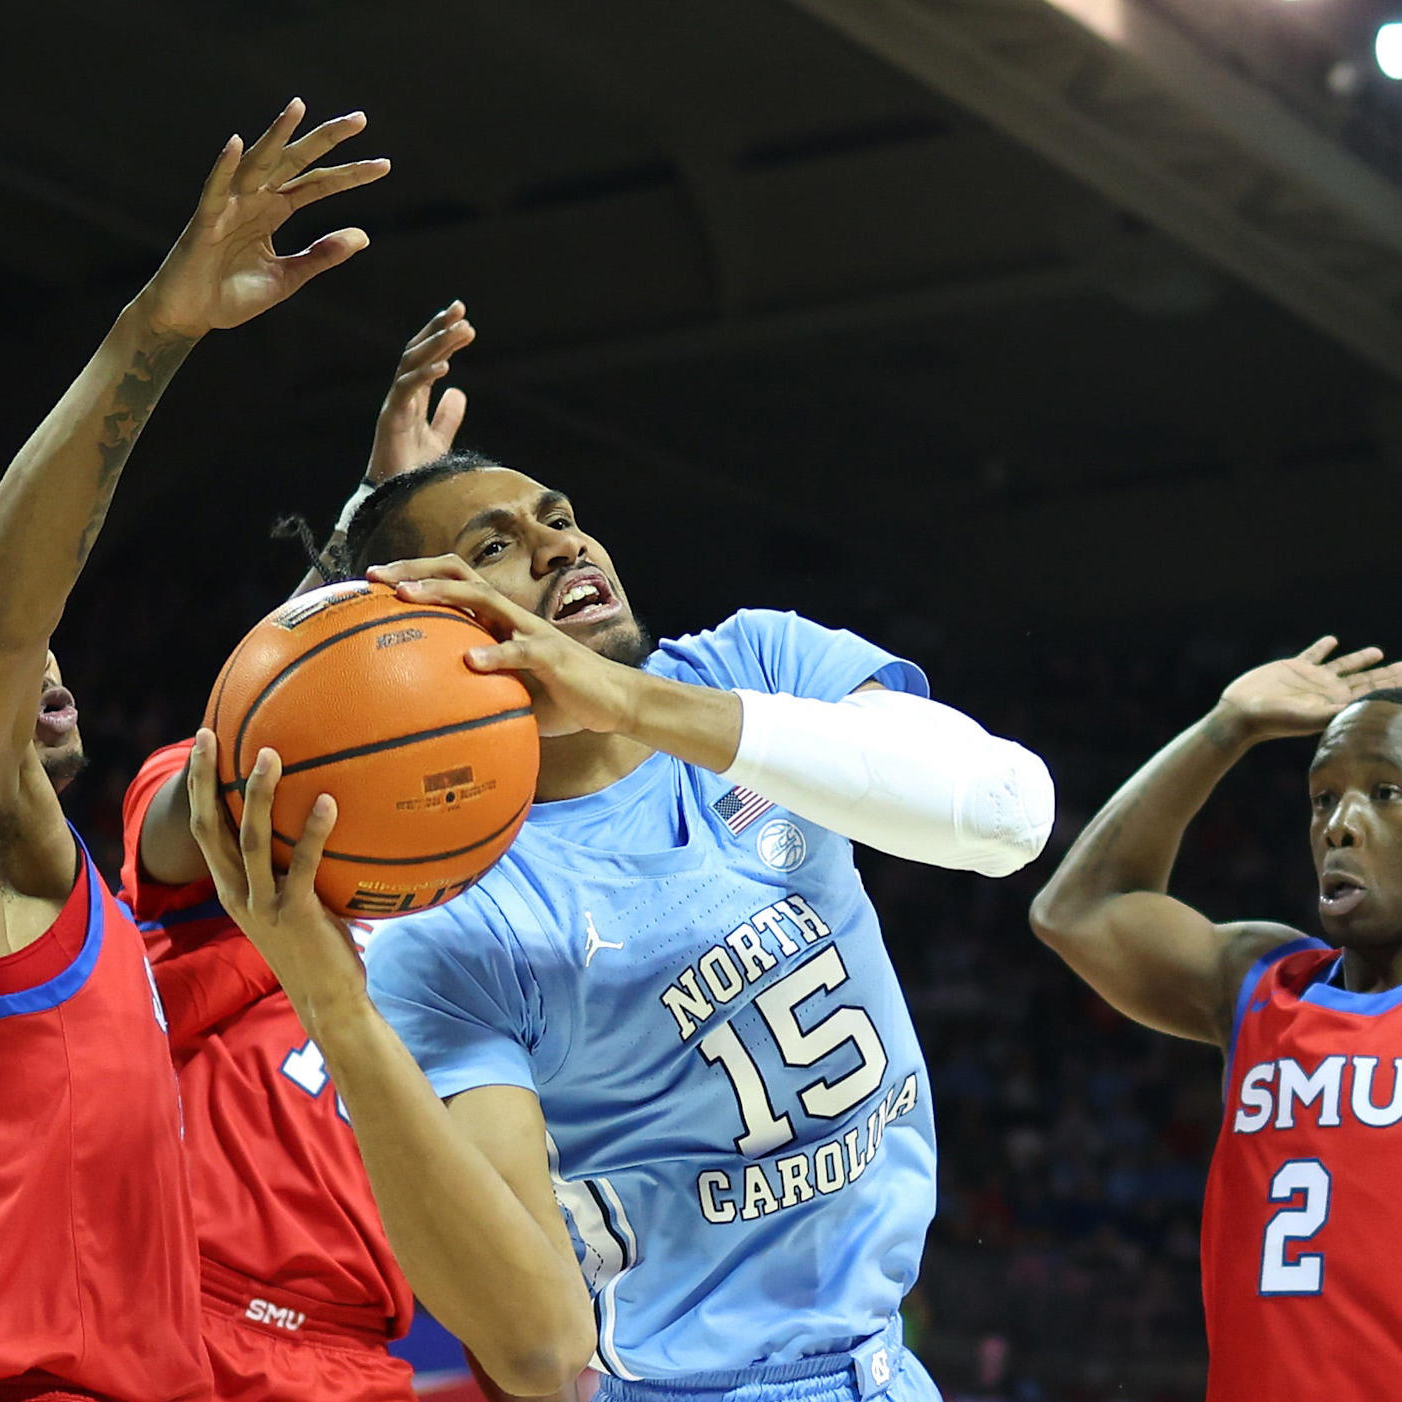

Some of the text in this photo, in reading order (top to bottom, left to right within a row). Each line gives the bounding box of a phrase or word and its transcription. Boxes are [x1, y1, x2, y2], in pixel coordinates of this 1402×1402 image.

[660, 893, 832, 1043] NORTH
[696, 940, 890, 1160] 15
[697, 1072, 919, 1224] CAROLINA
[1258, 1158, 1332, 1297] 2
[244, 1298, 306, 1332] SMU
